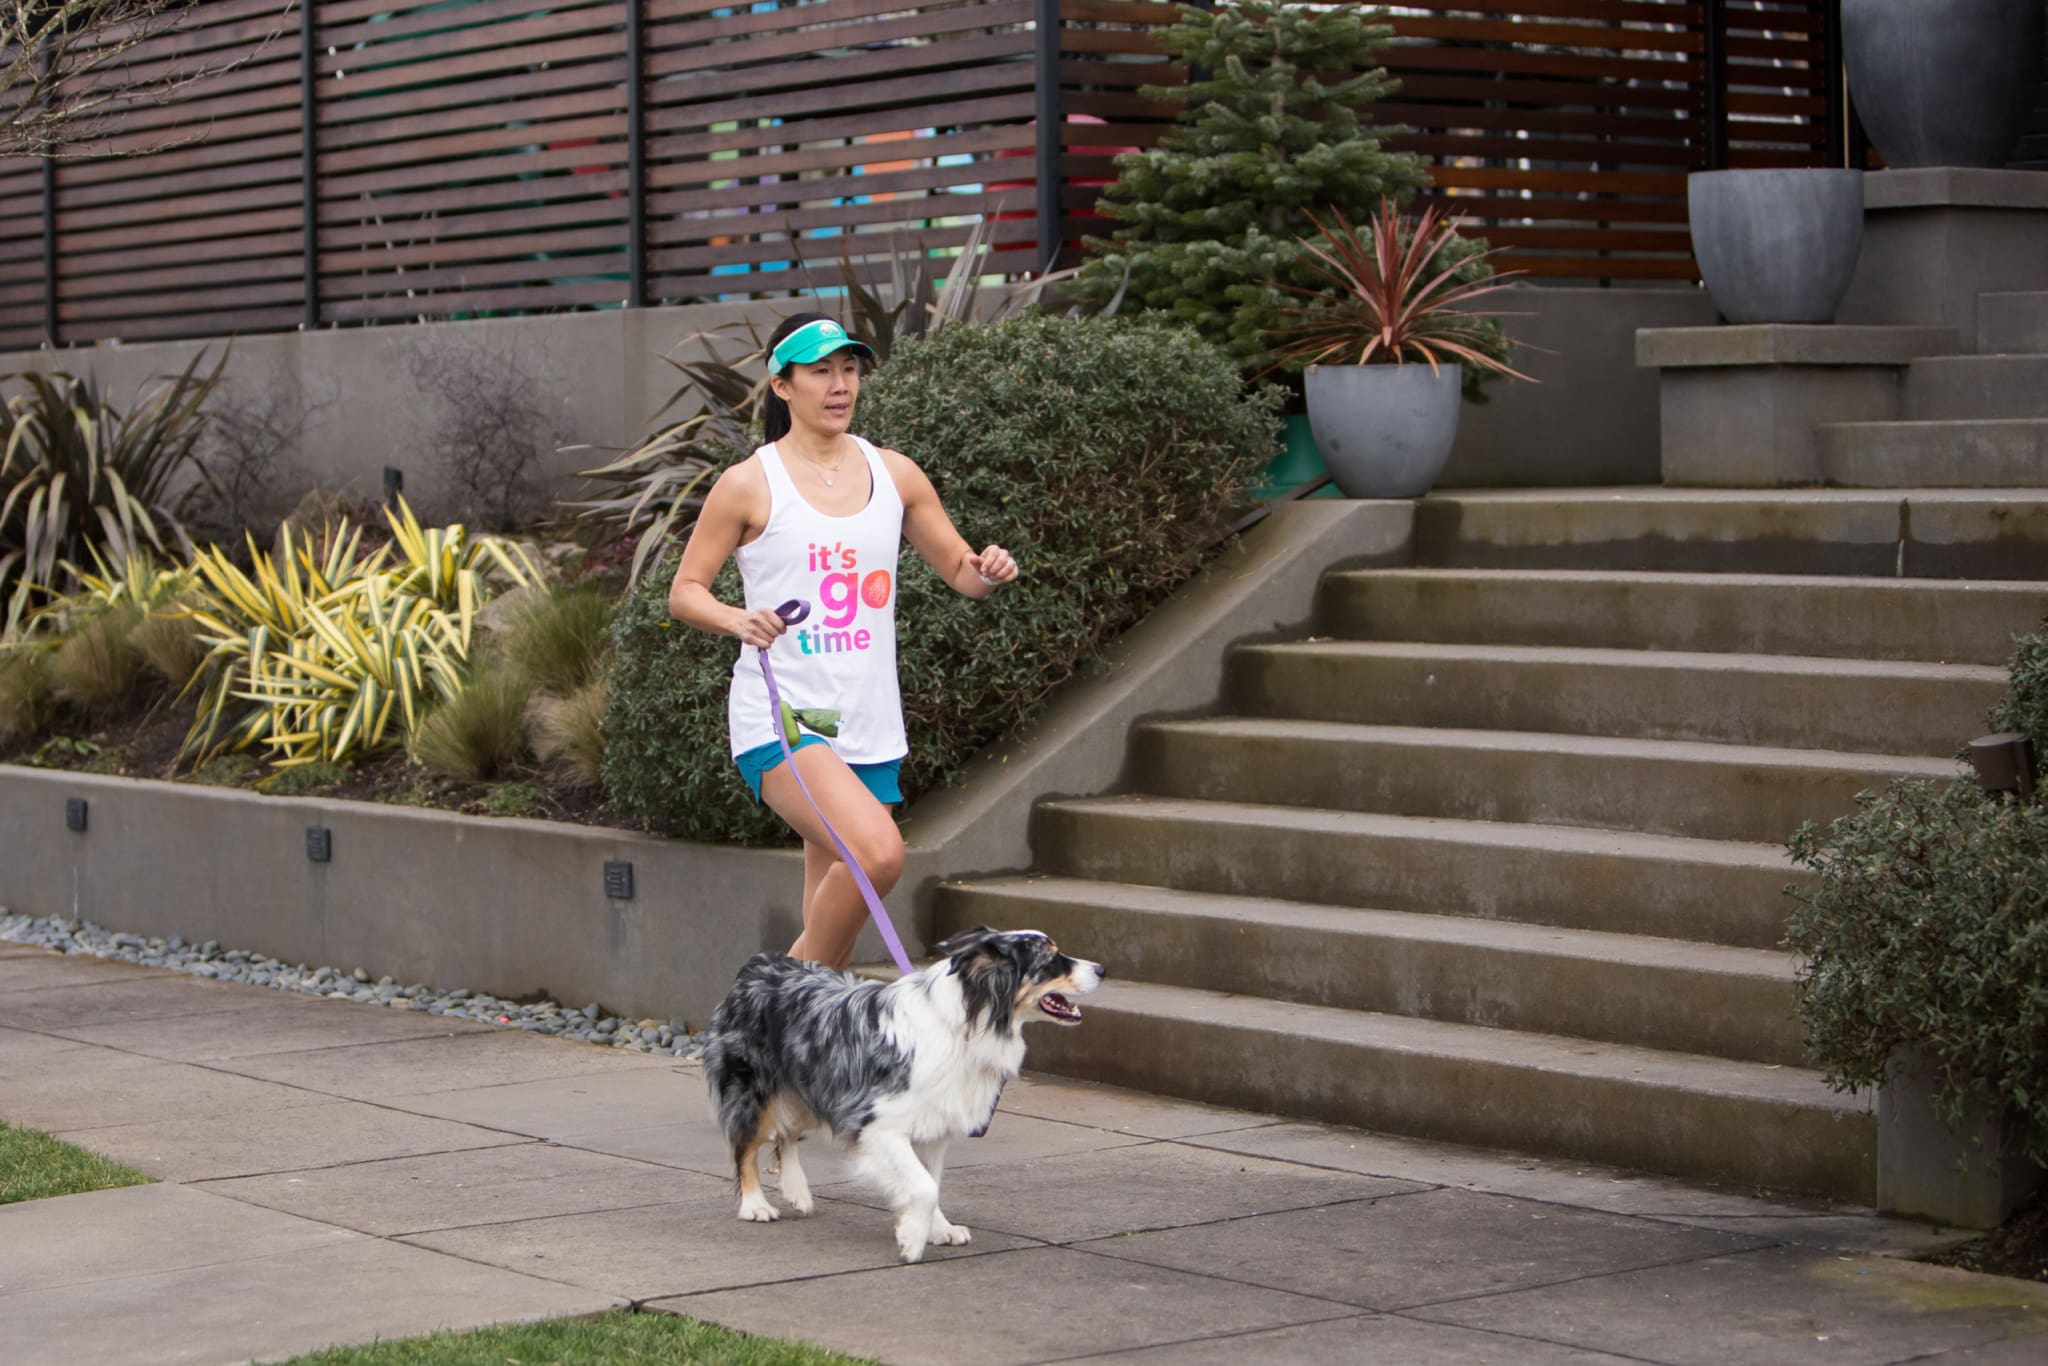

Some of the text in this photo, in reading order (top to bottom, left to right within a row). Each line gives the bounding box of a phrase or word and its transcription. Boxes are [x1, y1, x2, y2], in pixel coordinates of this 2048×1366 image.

[808, 541, 857, 572] it's
[819, 569, 891, 629] go
[797, 624, 871, 655] time
